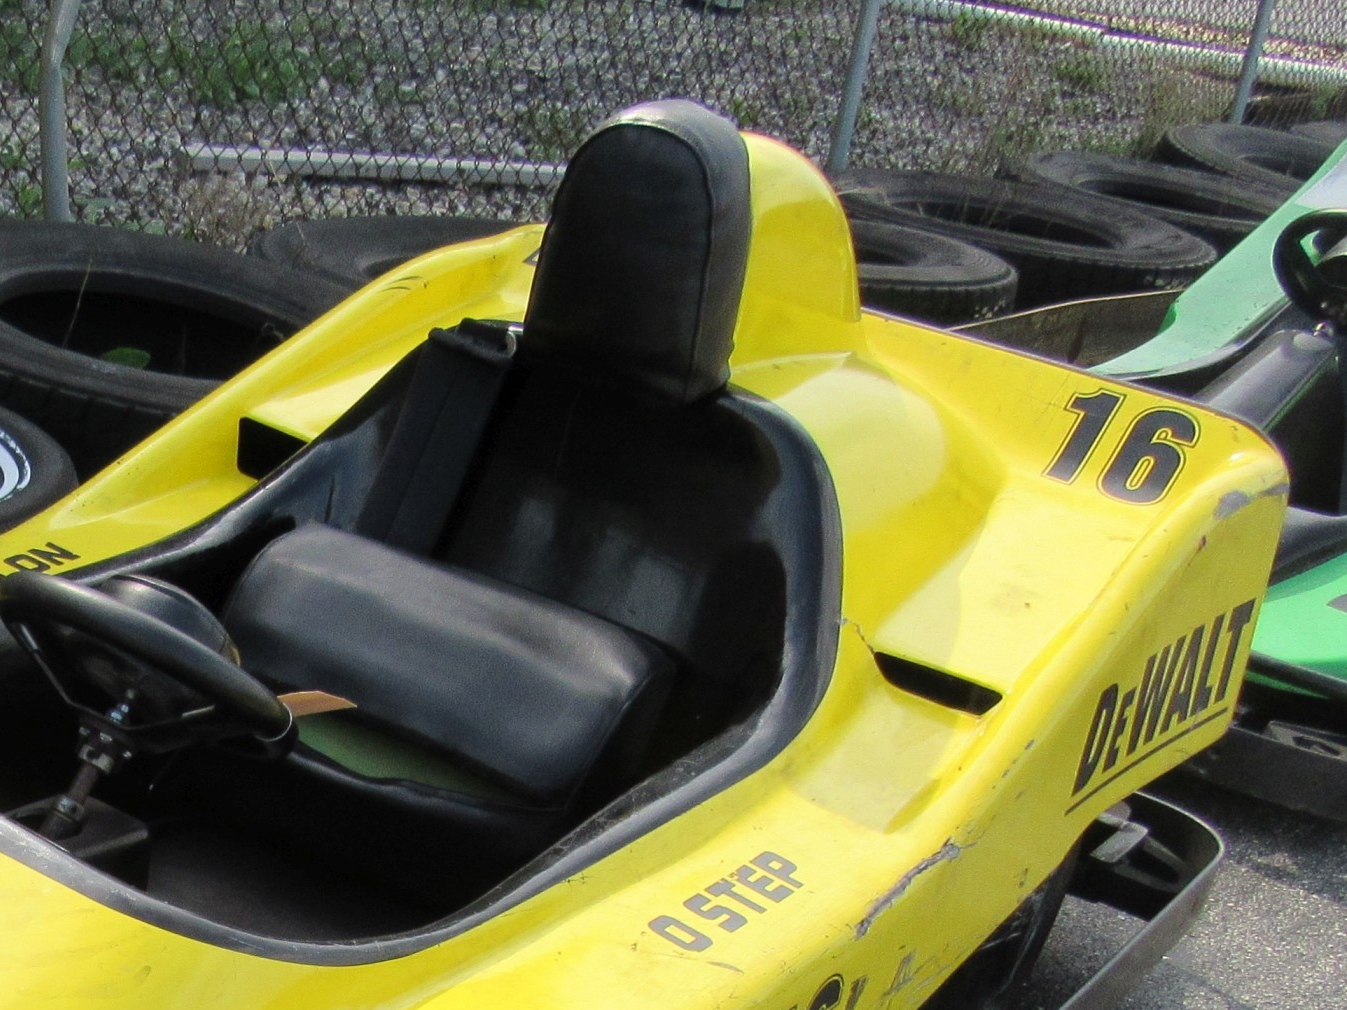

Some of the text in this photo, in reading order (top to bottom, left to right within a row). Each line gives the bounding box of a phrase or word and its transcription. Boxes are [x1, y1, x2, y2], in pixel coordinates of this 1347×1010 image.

[1042, 387, 1201, 505] 16
[5, 541, 81, 576] NO
[682, 850, 804, 933] STEP
